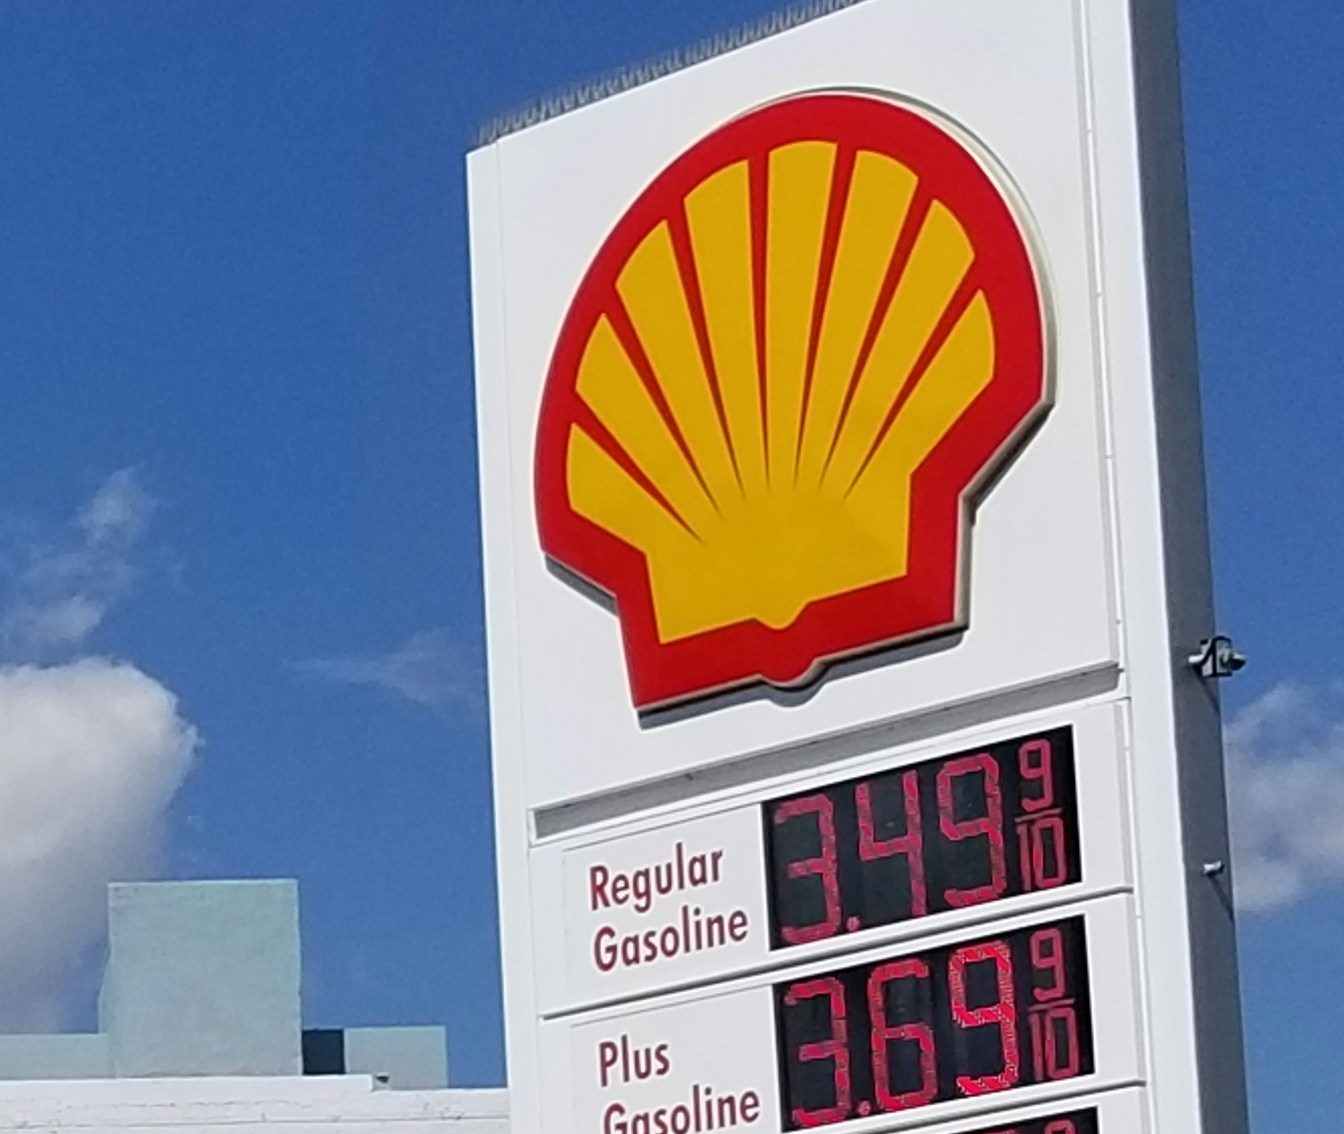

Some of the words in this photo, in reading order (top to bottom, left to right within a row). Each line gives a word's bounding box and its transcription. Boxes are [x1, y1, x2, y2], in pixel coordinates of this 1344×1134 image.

[588, 842, 725, 914] Regular
[773, 752, 1007, 945] 3.49
[593, 906, 750, 973] Gasoline
[598, 1036, 671, 1089] Plus
[785, 939, 1021, 1129] 3.69
